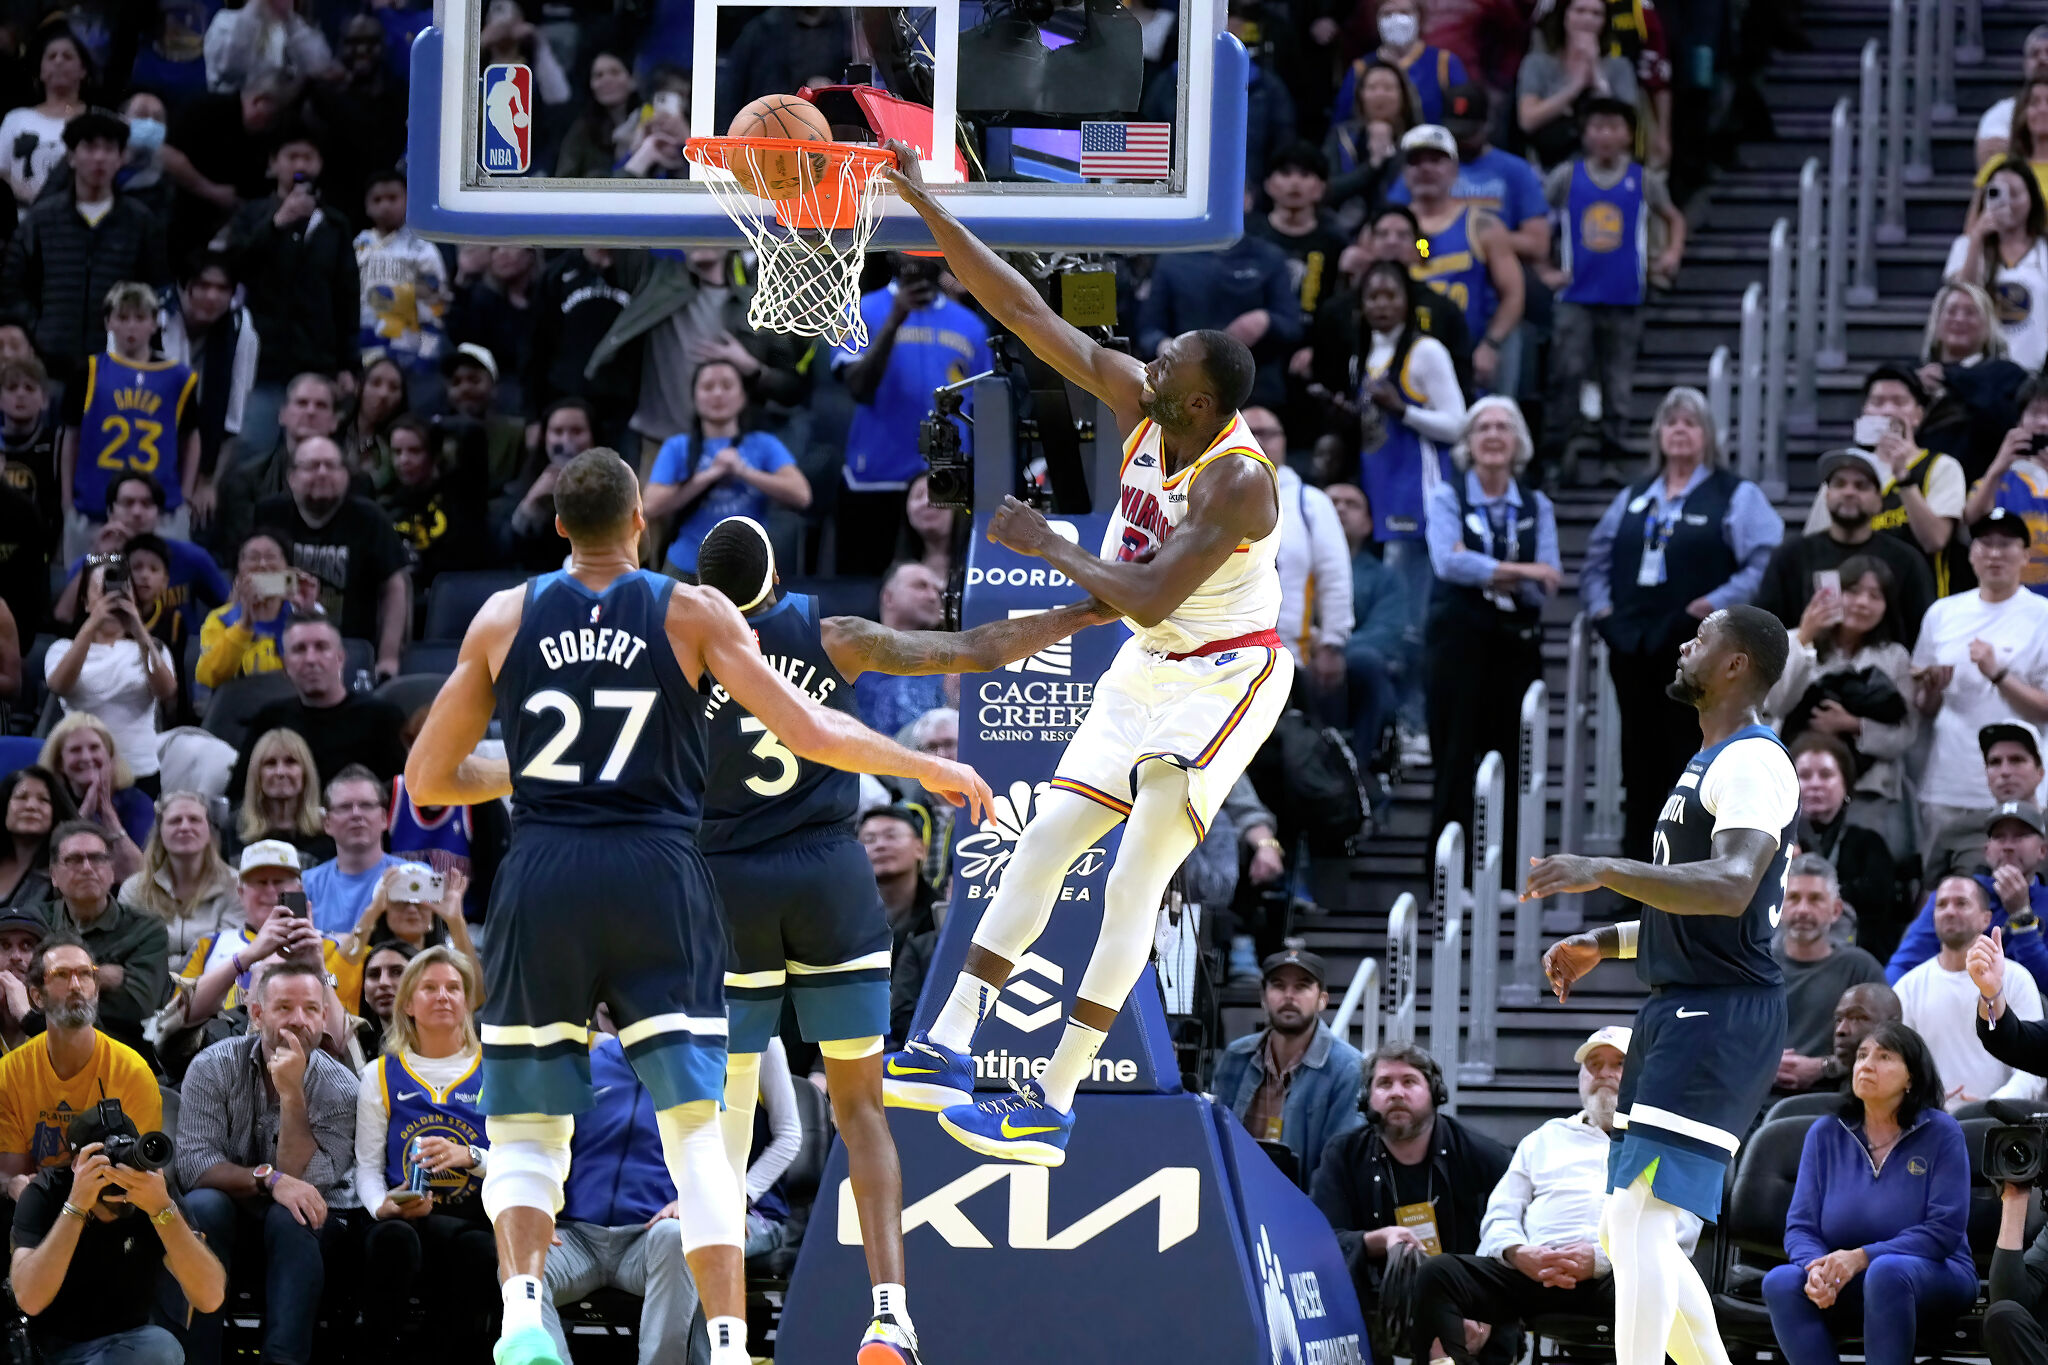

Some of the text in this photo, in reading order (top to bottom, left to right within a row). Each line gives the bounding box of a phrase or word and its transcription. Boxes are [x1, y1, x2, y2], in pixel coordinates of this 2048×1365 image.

[489, 148, 512, 166] NBA
[97, 415, 163, 473] 23
[1121, 484, 1175, 544] WARRIO
[966, 567, 1075, 587] DOORD
[539, 628, 647, 670] GOBERT
[979, 681, 1093, 704] CACHE
[978, 704, 1091, 727] CREEK
[521, 689, 657, 783] 27
[980, 729, 1075, 742] CASINO RESO
[740, 716, 799, 797] 3
[955, 831, 1107, 886] Sps
[967, 884, 998, 899] BA
[972, 1049, 1138, 1083] ntinene
[400, 1114, 479, 1141] GOLDEN STATE
